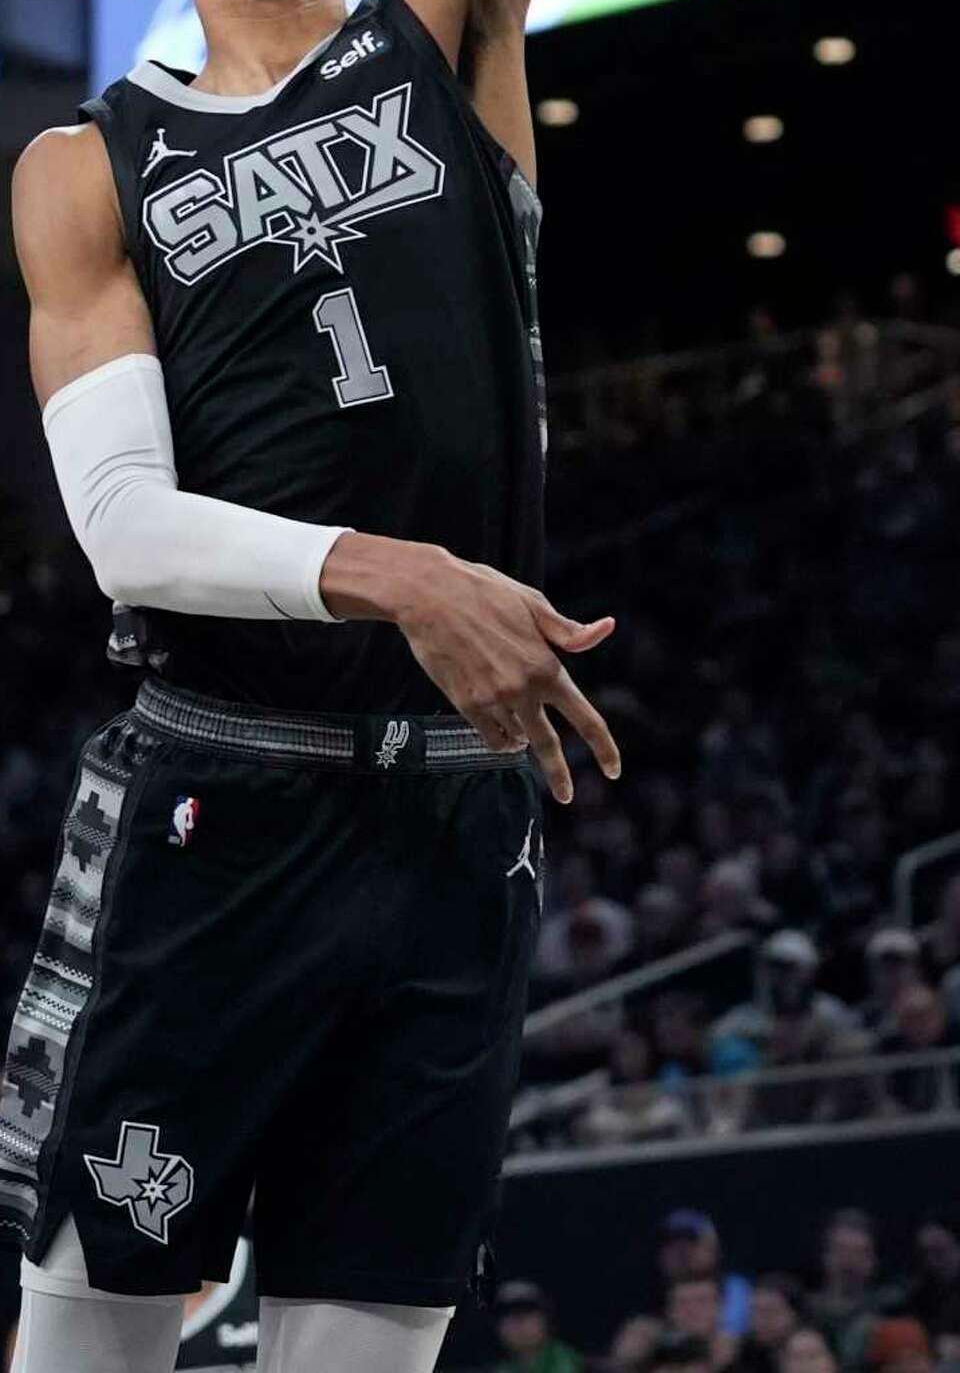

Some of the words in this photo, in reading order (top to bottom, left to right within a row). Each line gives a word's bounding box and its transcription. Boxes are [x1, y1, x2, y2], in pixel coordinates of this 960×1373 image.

[320, 30, 385, 80] Self.
[142, 81, 445, 287] SATX
[312, 287, 394, 409] 1
